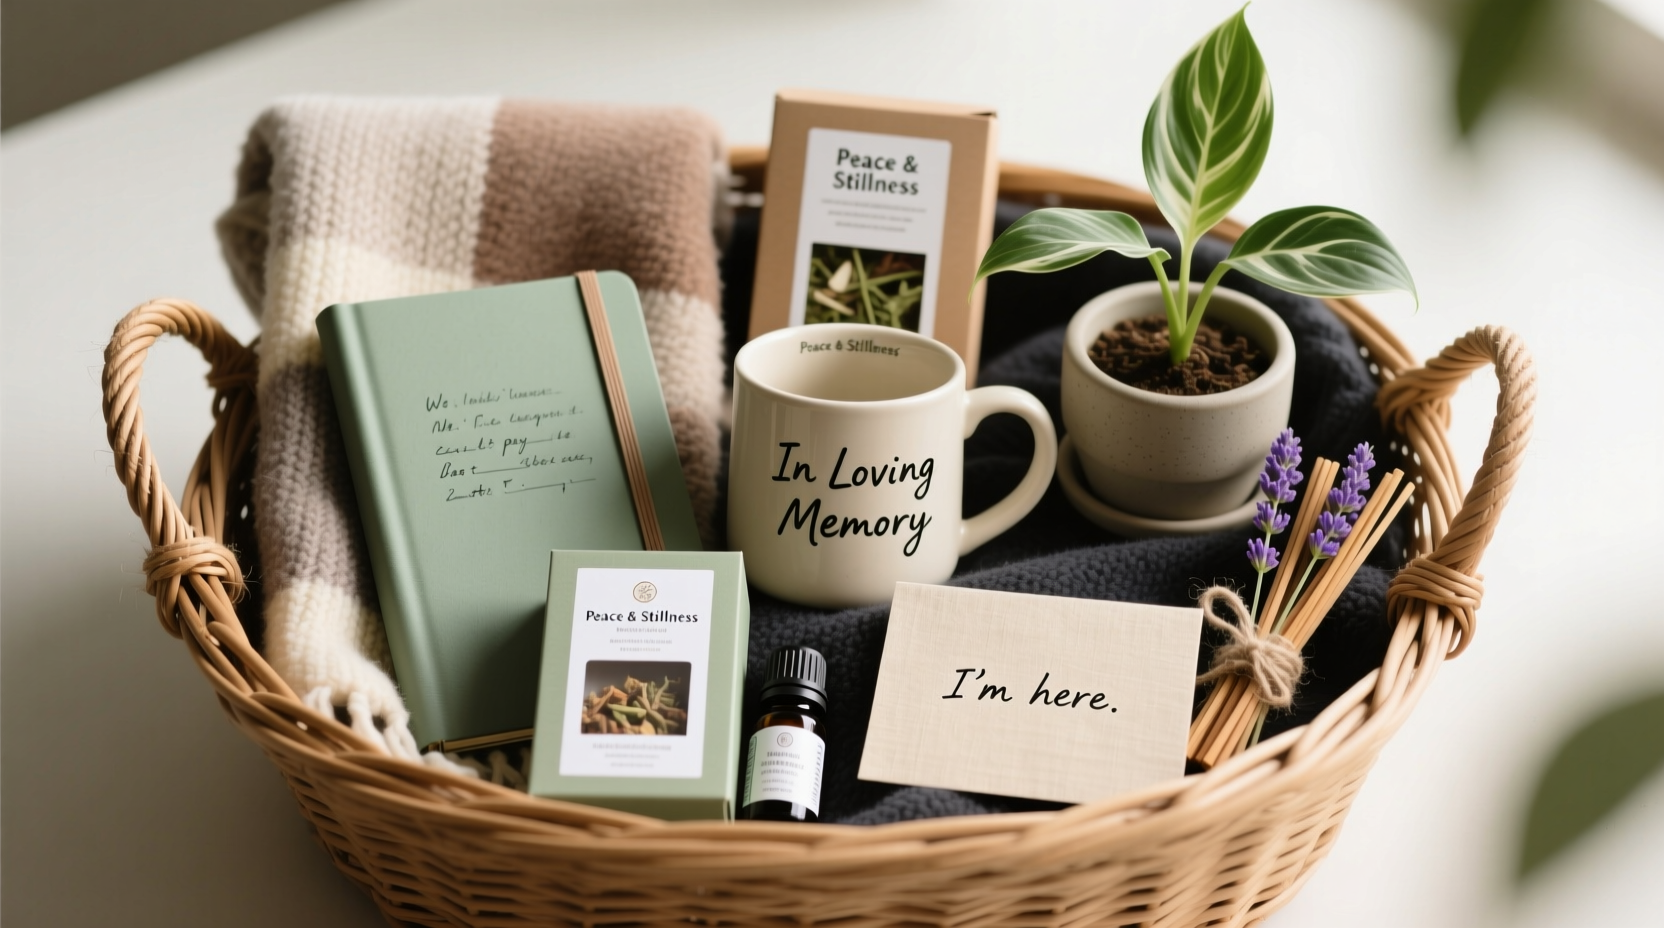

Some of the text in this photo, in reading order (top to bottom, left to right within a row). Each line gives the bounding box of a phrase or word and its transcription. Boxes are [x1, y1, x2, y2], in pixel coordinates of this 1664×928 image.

[836, 147, 918, 173] Peace &
[832, 171, 919, 196] Stillness
[771, 442, 934, 500] In Loving
[777, 498, 932, 557] Memory
[586, 610, 698, 623] Peace & Stillness
[941, 668, 1117, 713] I’m here.
